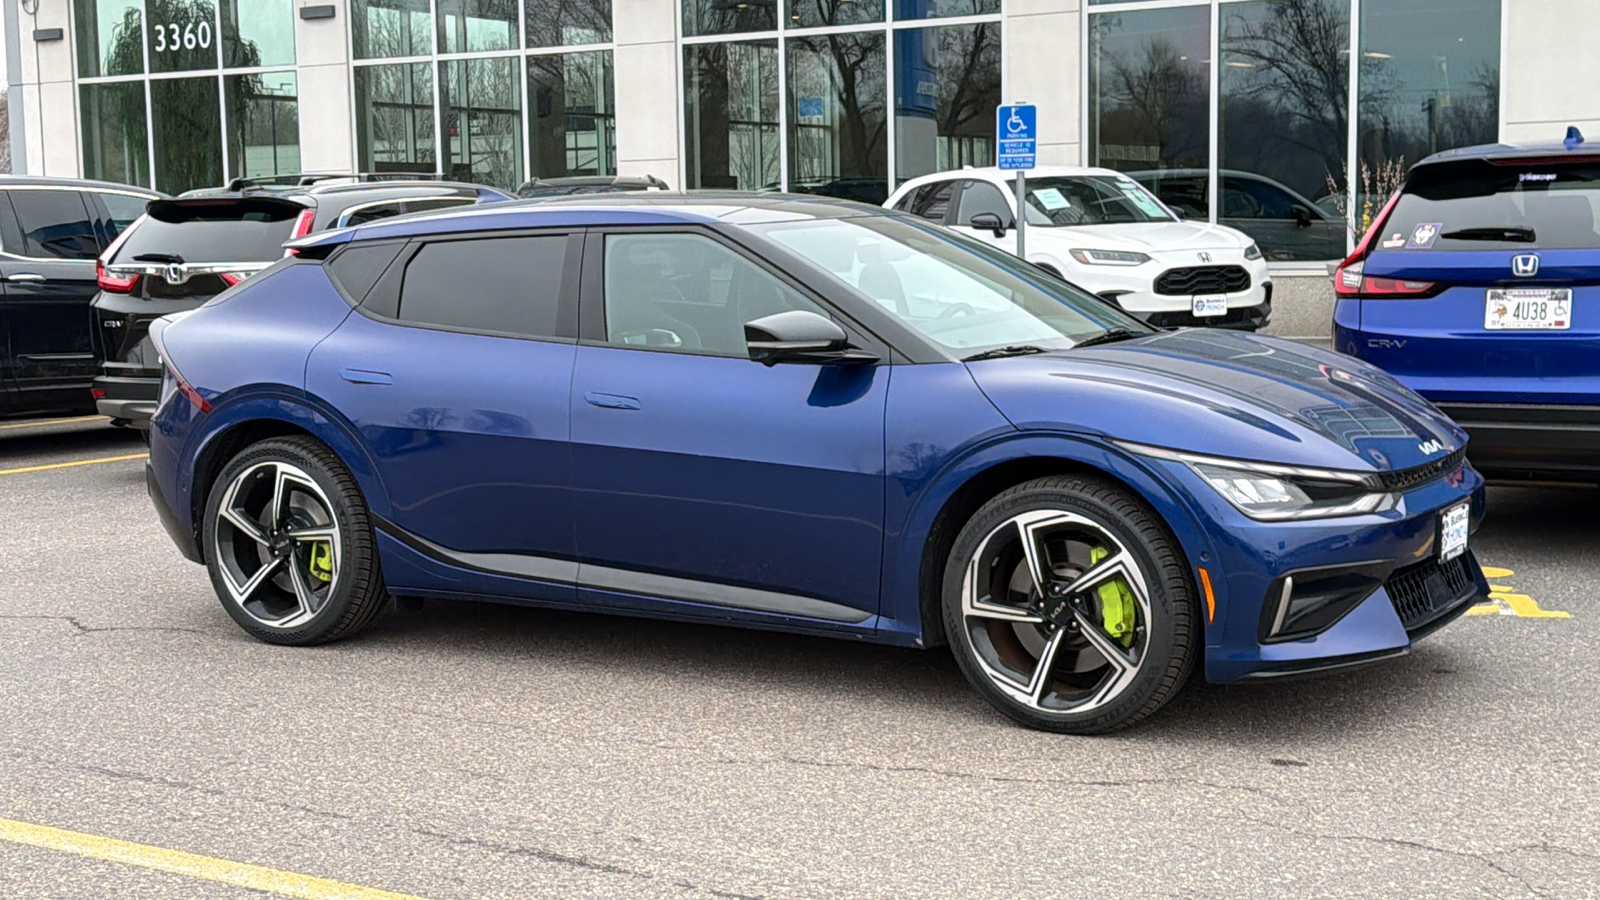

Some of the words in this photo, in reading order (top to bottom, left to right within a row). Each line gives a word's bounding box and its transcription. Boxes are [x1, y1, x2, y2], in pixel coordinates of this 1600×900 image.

[154, 21, 211, 52] 3360
[1512, 301, 1548, 321] 4U38
[1367, 339, 1407, 348] CR-V
